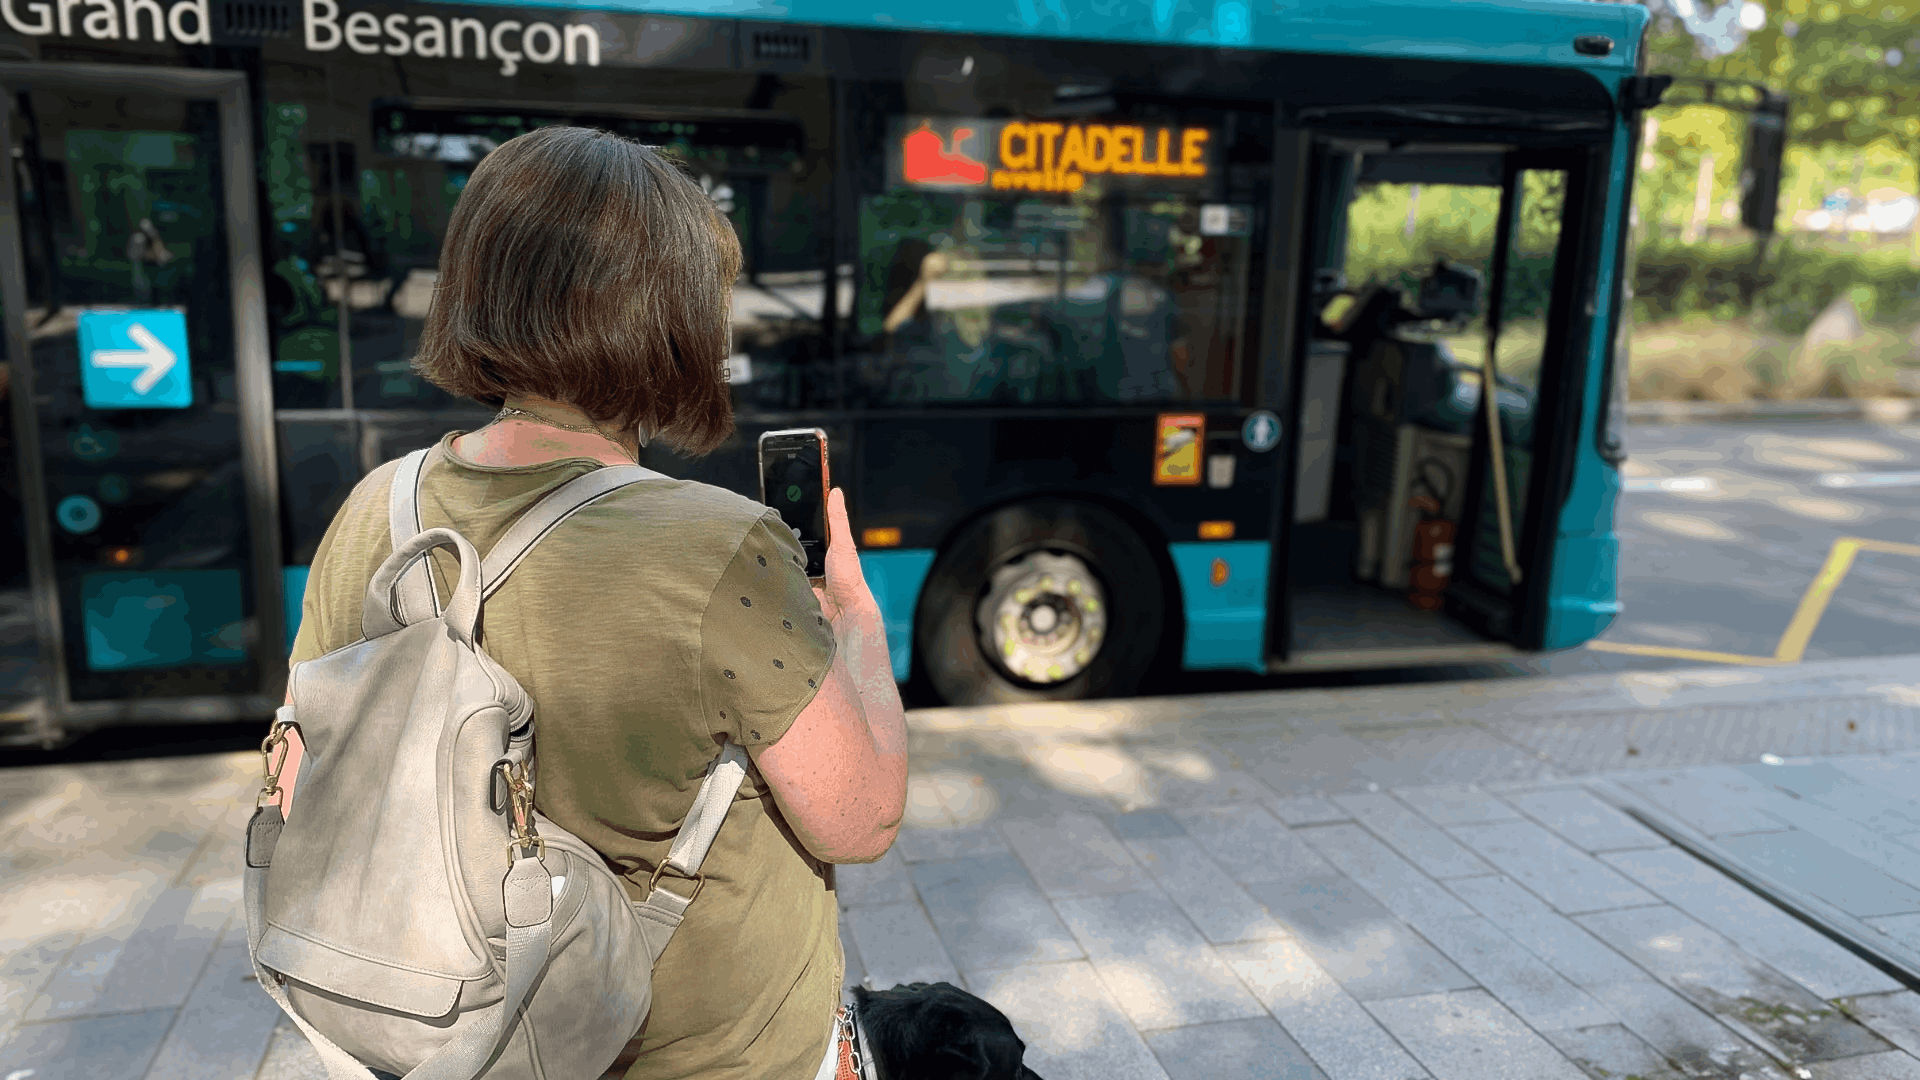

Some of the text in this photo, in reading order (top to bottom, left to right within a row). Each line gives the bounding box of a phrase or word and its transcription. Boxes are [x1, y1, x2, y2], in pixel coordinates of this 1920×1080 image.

[0, 0, 600, 76] Grand Besançon
[1000, 122, 1209, 177] CITADELLE
